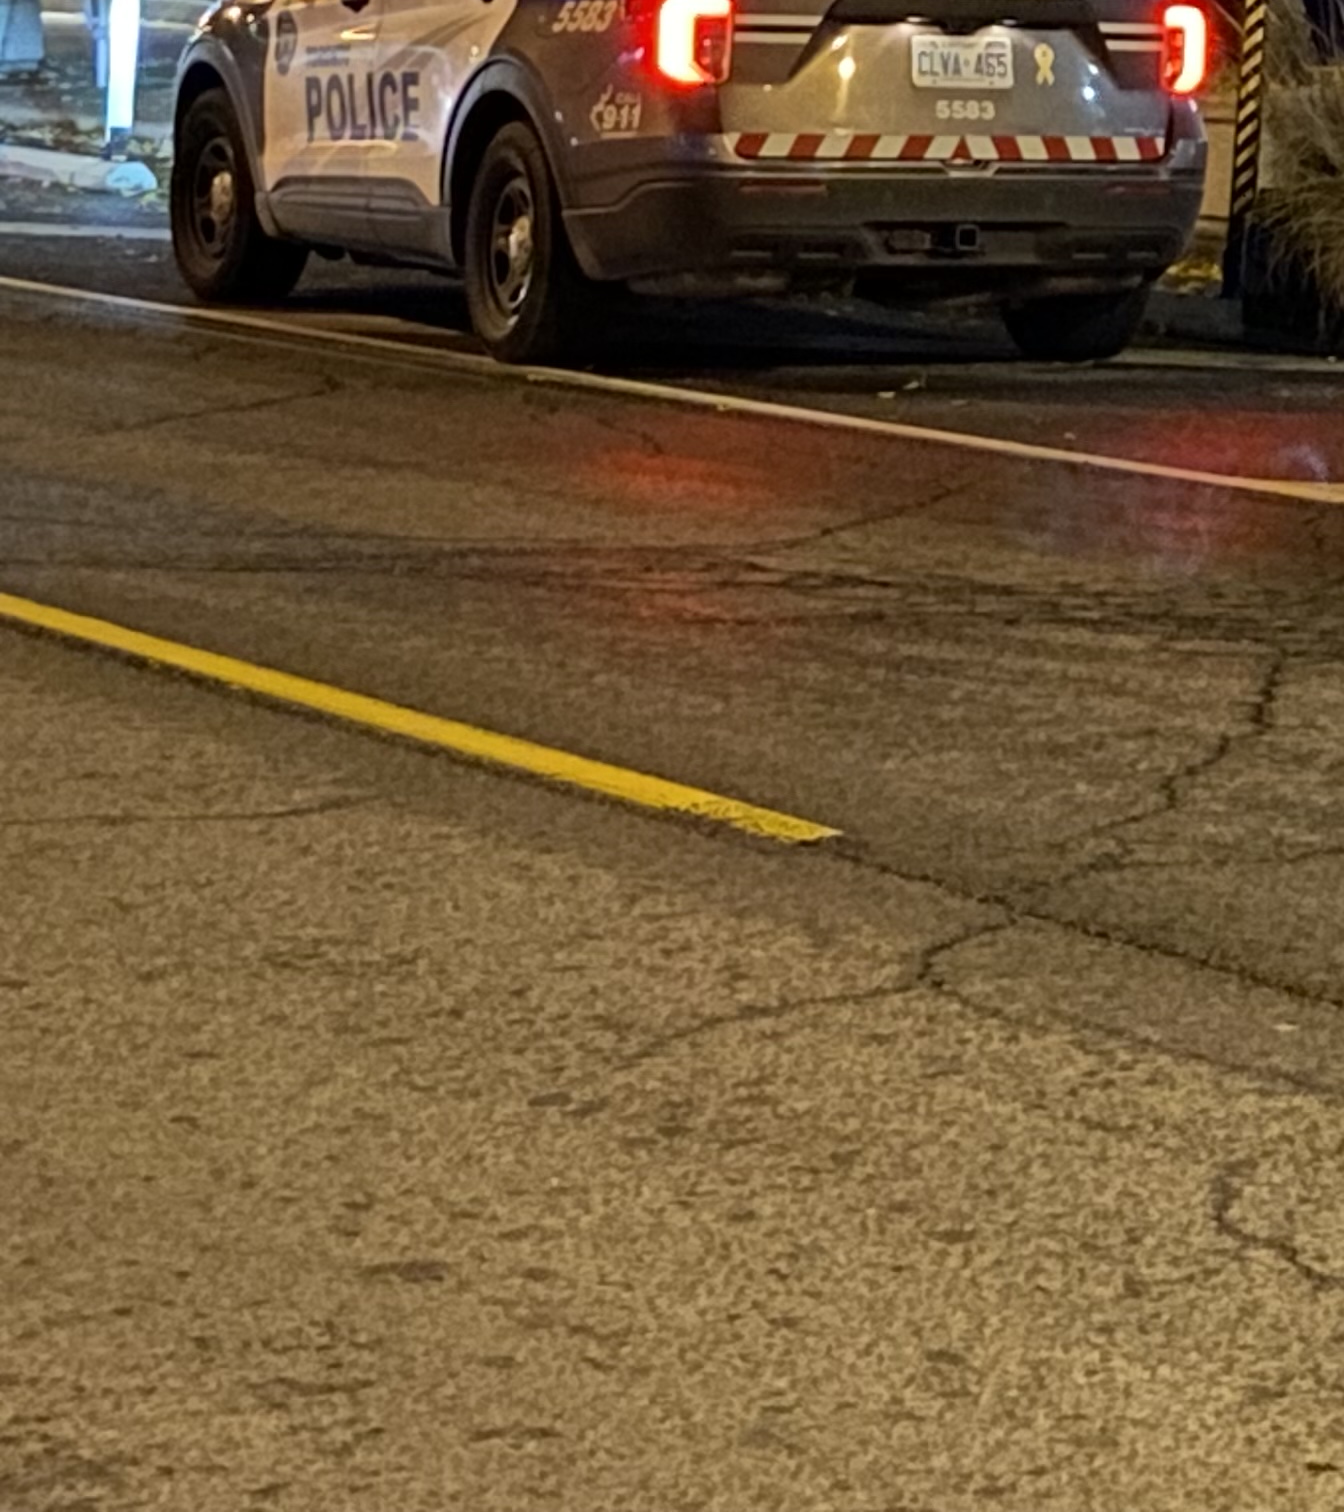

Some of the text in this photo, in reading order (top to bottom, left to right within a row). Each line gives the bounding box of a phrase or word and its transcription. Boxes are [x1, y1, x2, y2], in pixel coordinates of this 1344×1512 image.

[552, 0, 618, 33] 5583
[305, 71, 420, 143] POLICE
[936, 99, 996, 121] 5583
